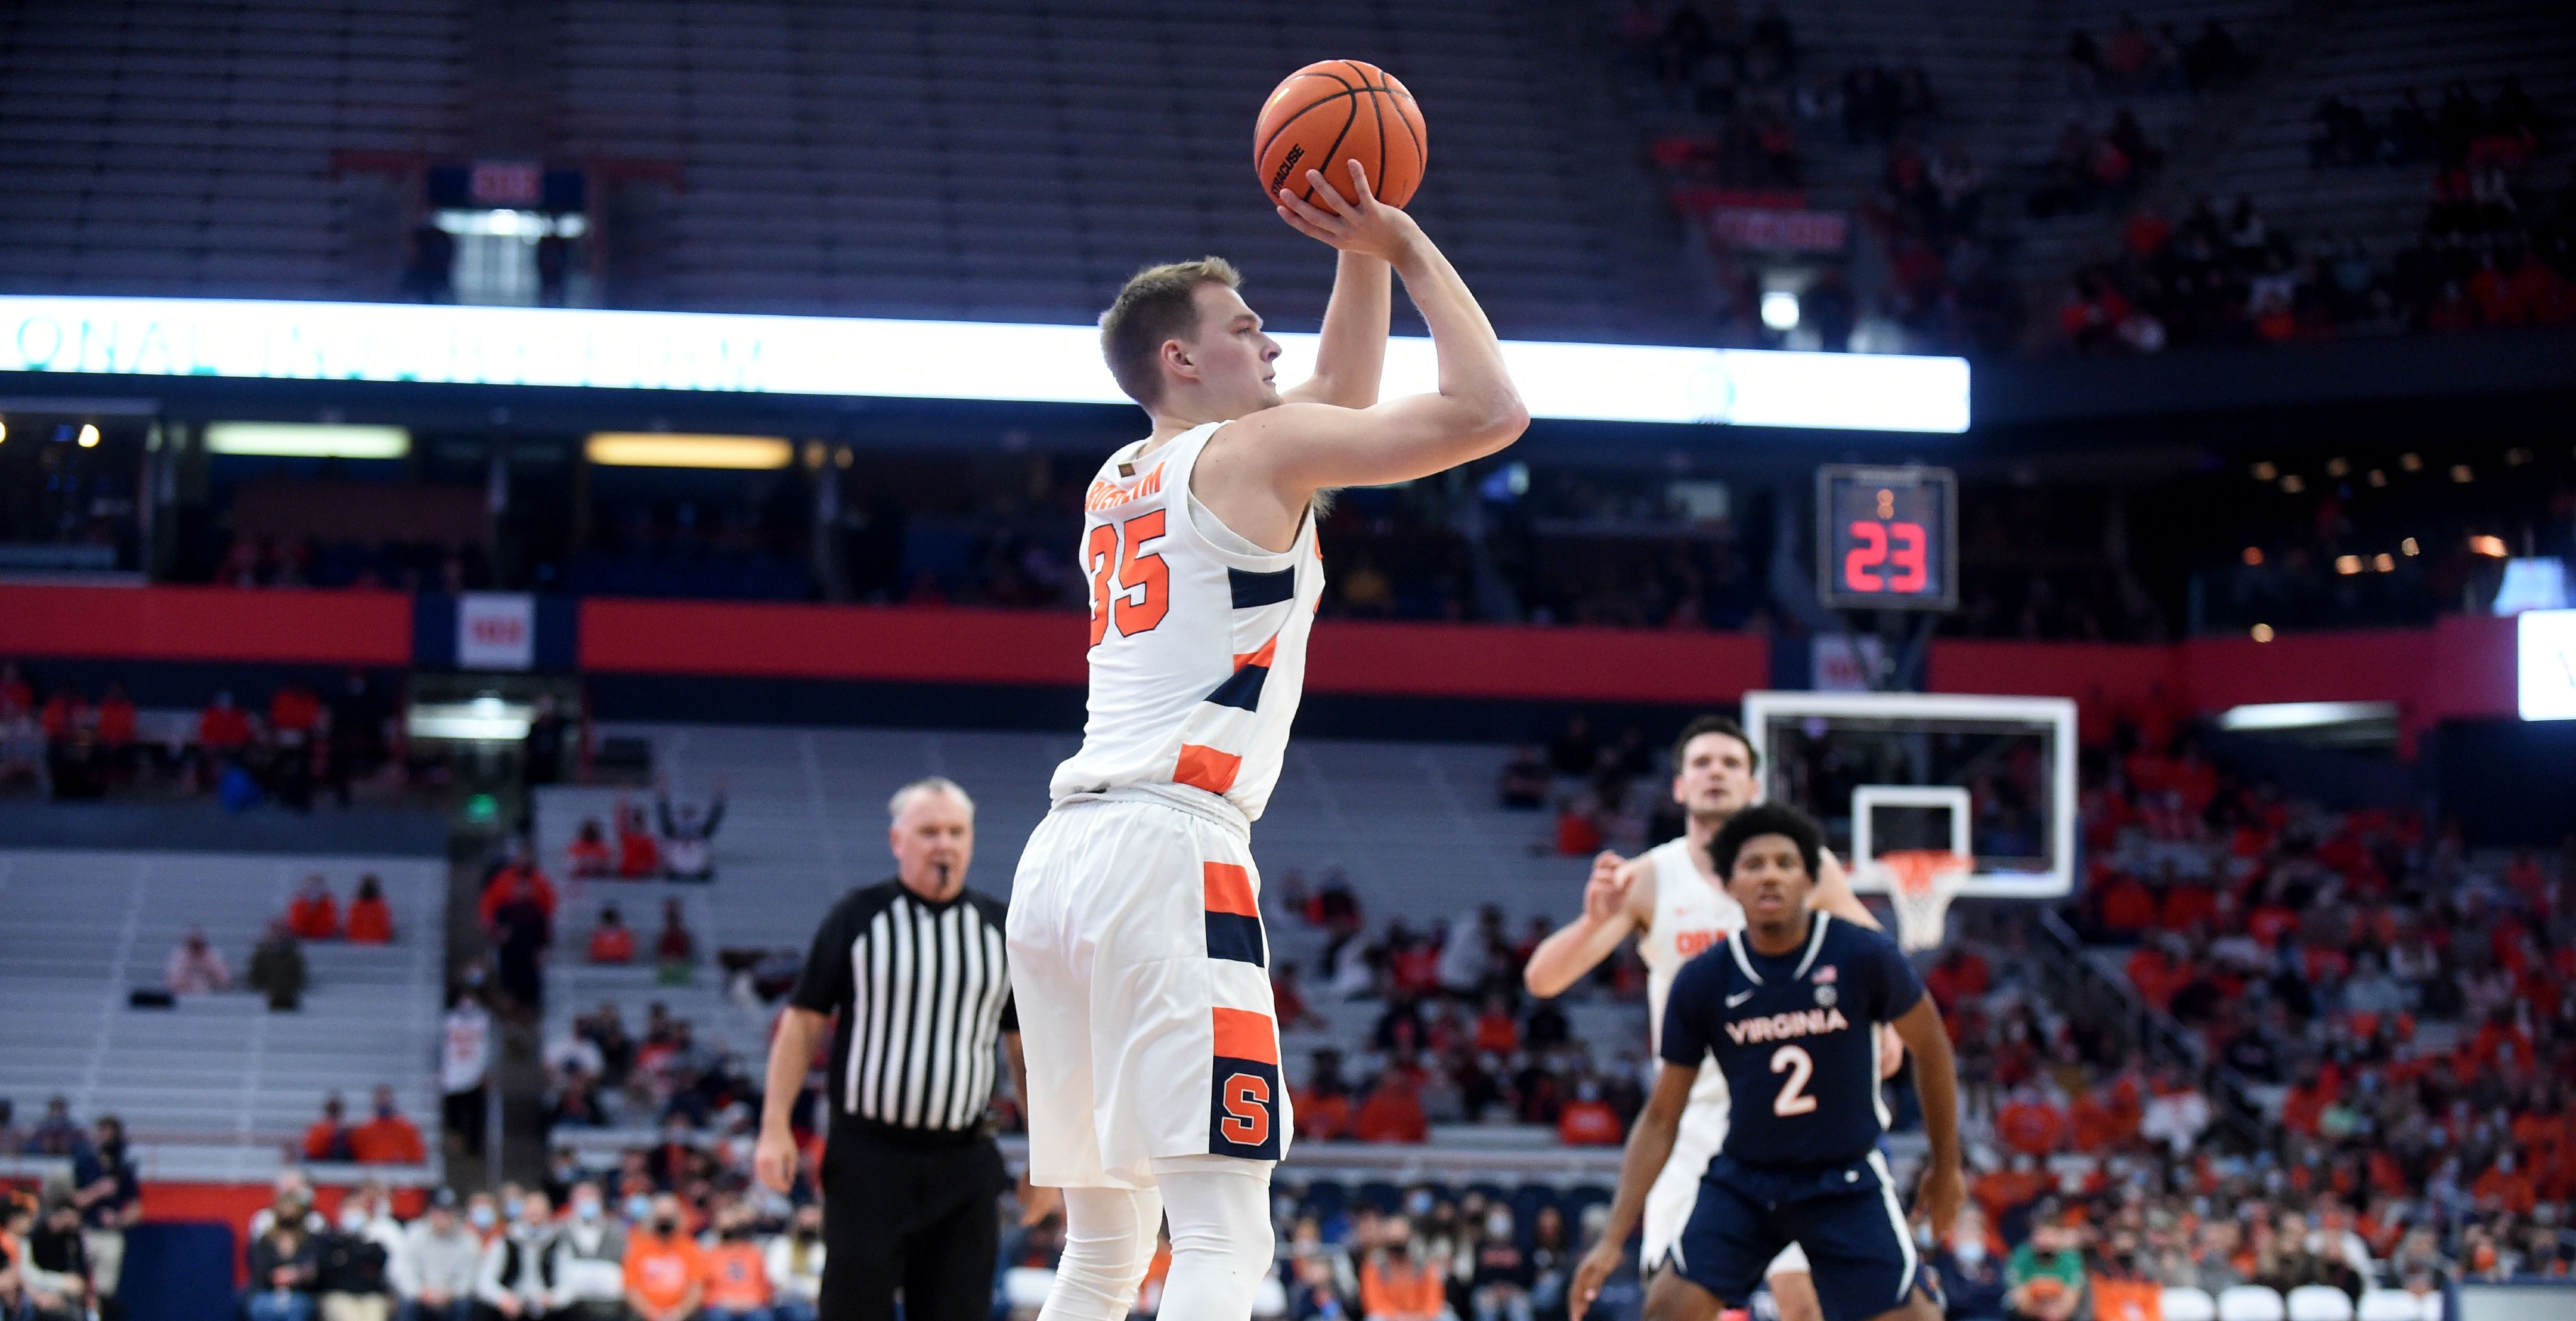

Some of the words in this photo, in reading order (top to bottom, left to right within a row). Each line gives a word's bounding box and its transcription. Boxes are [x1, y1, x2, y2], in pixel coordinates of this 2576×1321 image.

[1272, 143, 1305, 198] SYRACUSE
[1089, 508, 1169, 647] 35
[1845, 520, 1926, 593] 23
[1725, 1008, 1849, 1045] VIRGINIA
[1221, 1073, 1270, 1146] S
[1770, 1045, 1818, 1117] 2
